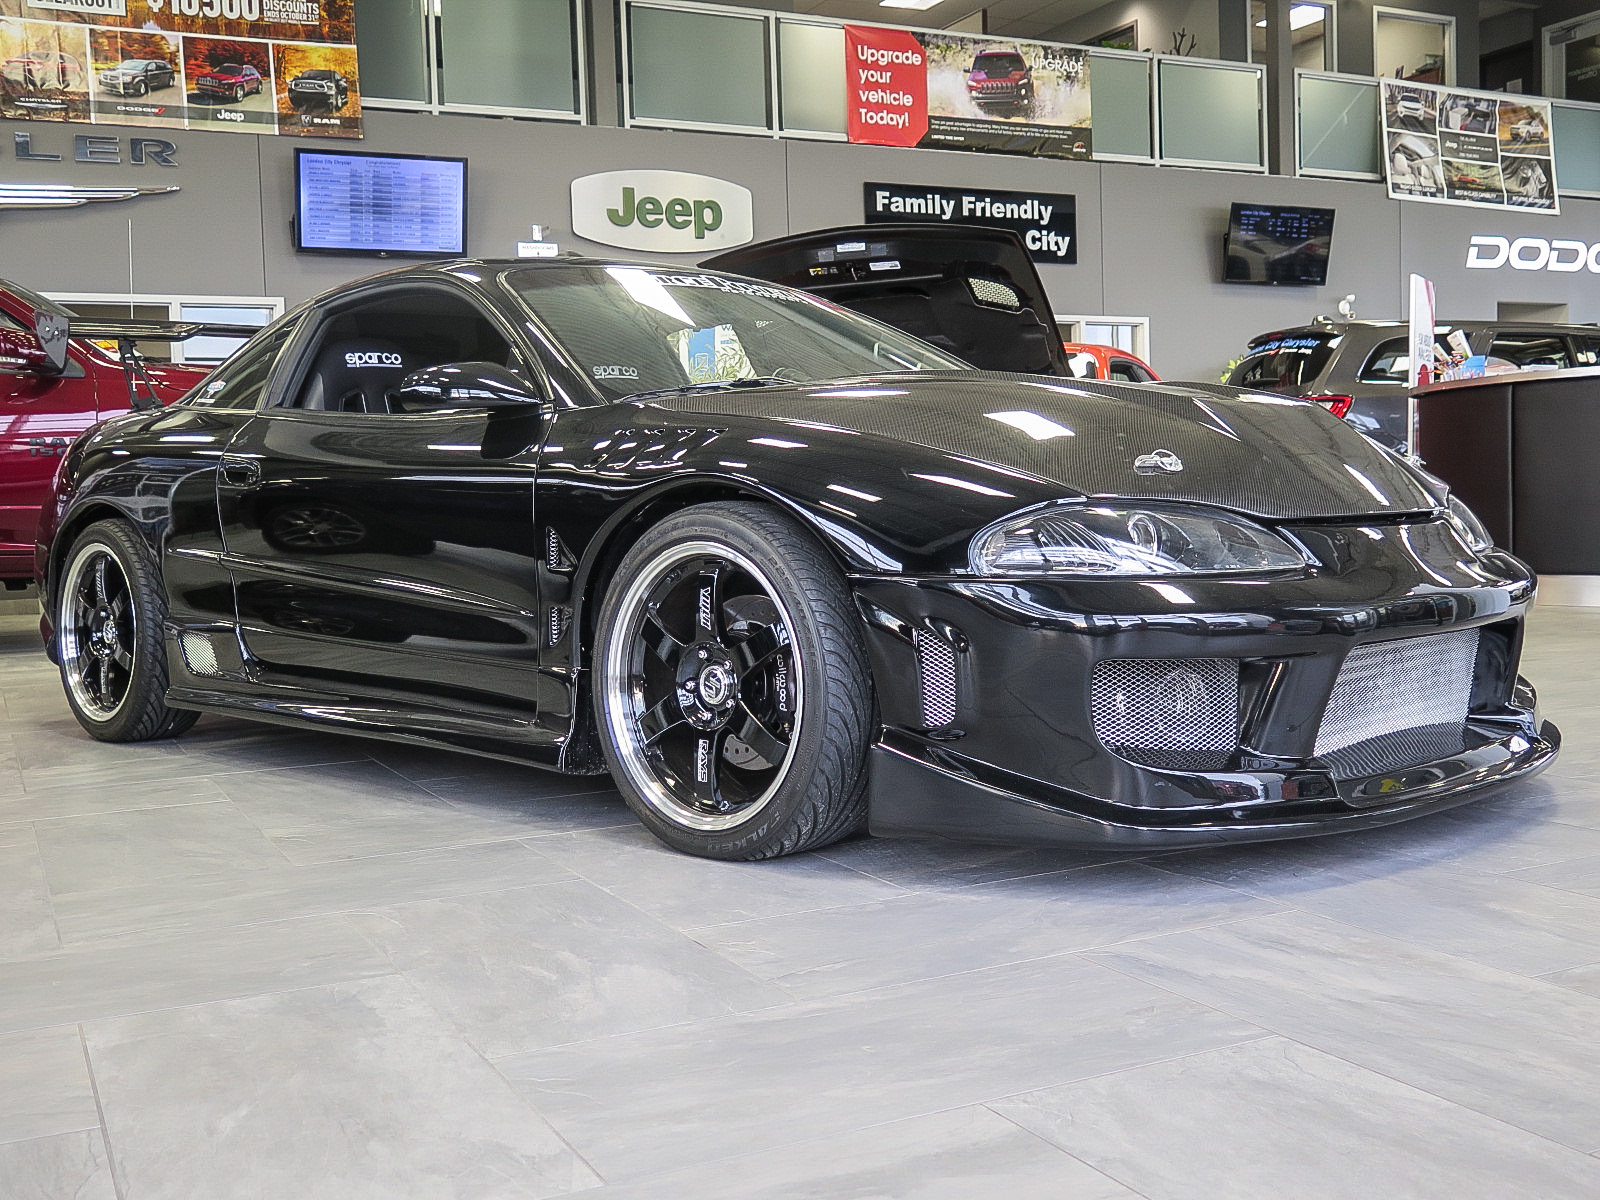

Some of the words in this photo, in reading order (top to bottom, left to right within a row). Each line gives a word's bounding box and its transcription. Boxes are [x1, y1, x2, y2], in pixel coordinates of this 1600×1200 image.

[263, 0, 319, 14] DISCOUNTS
[264, 10, 279, 18] ENDS
[281, 12, 307, 20] OCTOBER
[857, 44, 922, 66] Upgrade
[1032, 55, 1084, 72] UPGRADE
[858, 68, 892, 84] your
[859, 88, 914, 107] vehicle
[217, 109, 244, 122] Jeep
[859, 108, 910, 129] Today!
[606, 187, 723, 239] Jeep
[875, 190, 955, 220] Family
[962, 195, 1053, 225] Friendly
[1025, 229, 1070, 256] City
[1265, 340, 1281, 350] City
[1281, 337, 1321, 349] Chrysler
[345, 352, 402, 368] sparco
[592, 365, 638, 379] sparco
[699, 739, 709, 783] RAYS
